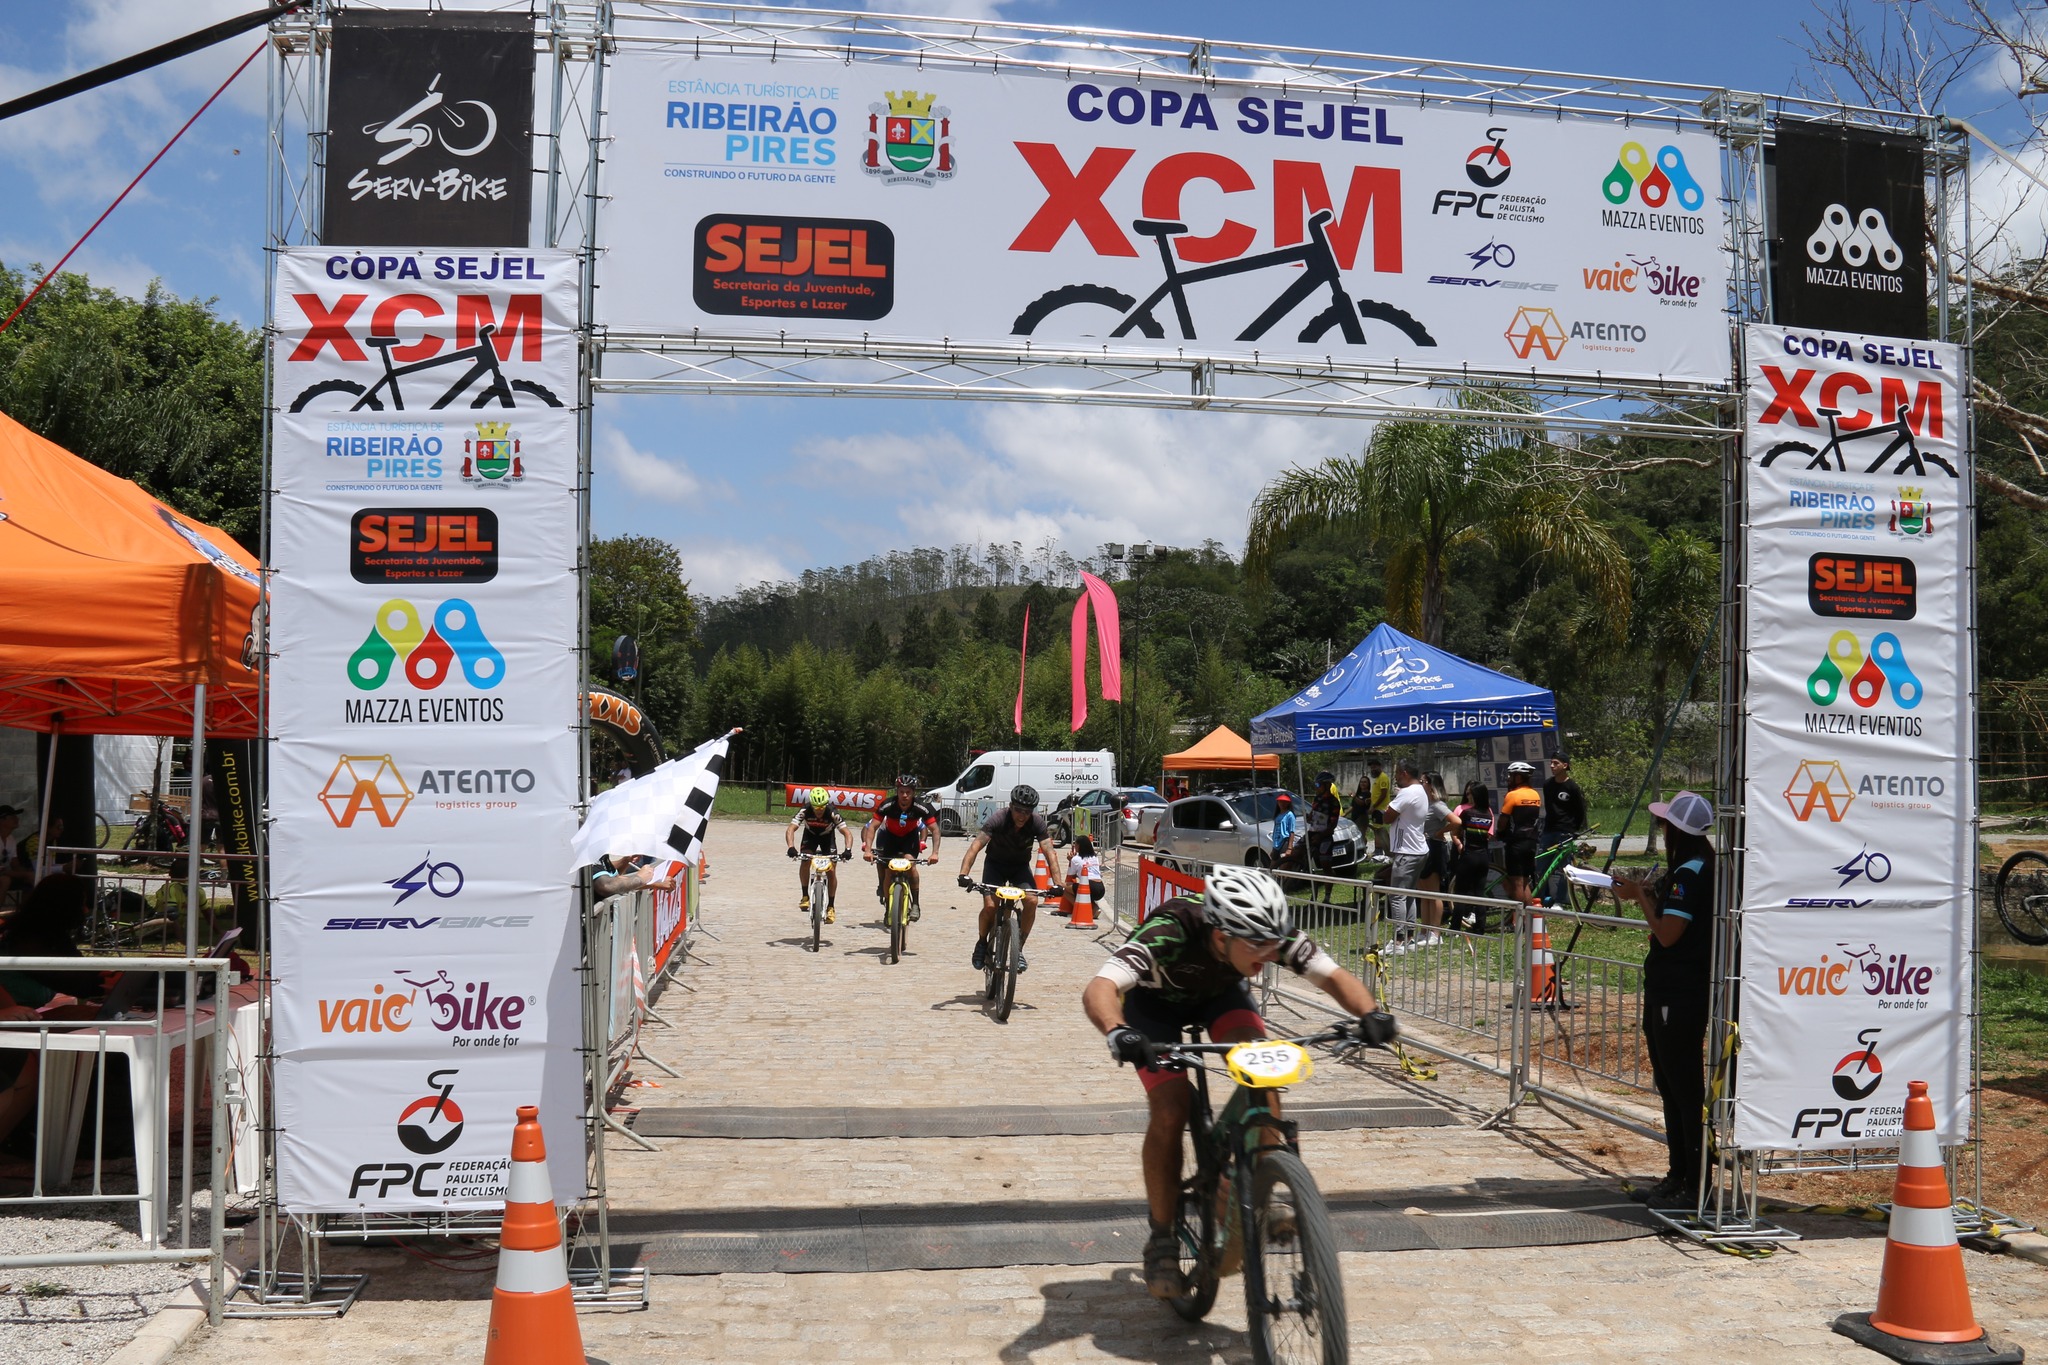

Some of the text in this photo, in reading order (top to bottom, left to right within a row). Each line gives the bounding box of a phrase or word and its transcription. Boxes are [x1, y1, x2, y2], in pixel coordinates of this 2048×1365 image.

[668, 78, 840, 100] ESTÂNCIA TURÍSTICA DE
[666, 101, 837, 135] RIBEIRÃO
[1067, 84, 1404, 146] COPA SEJEL
[726, 134, 836, 166] PIRES
[664, 168, 836, 184] CONSTRUINDO O FUTURO DA GENTE
[1007, 141, 1403, 274] XCM
[1432, 189, 1498, 219] FPC
[1499, 204, 1536, 214] PAULISTA
[1501, 194, 1547, 205] FEDERAÇÃO
[1497, 212, 1545, 224] DE CICLISMO
[1602, 209, 1705, 236] MAZZA EVENTOS
[704, 223, 886, 278] SEJEL
[325, 256, 545, 281] COPA SEJEL
[713, 279, 876, 297] Secretaria da Juventude,
[1806, 266, 1903, 293] MAZZA EVENTOS
[741, 296, 848, 311] Esportes e Lazer
[1671, 299, 1686, 307] onde
[1688, 300, 1698, 309] for
[287, 293, 543, 363] XCM
[1570, 321, 1647, 343] ATENTO
[1582, 343, 1636, 354] logistics group
[1783, 335, 1943, 370] COPA SEJEL
[1757, 365, 1944, 439] XCM
[327, 419, 444, 432] ESTÂNCIA TURÍSTICA DE
[326, 433, 443, 457] RIBEIRÃO
[367, 458, 443, 478] PIRES
[1789, 490, 1876, 512] RIBEIRÃO
[1820, 511, 1876, 530] PIRES
[358, 514, 493, 553] SEJEL
[364, 556, 484, 566] Secretaria da Juventude,
[385, 569, 426, 579] Esportes
[437, 569, 464, 577] Lazer
[1814, 558, 1913, 594] SEJEL
[1819, 593, 1856, 603] Secretaria
[1835, 604, 1866, 614] Esportes
[1873, 607, 1893, 615] Lazer
[345, 697, 504, 723] MAZZA EVENTOS
[577, 691, 643, 736] XXIS
[1307, 723, 1355, 741] Team
[1362, 713, 1446, 737] Serv-Bike
[1452, 706, 1541, 731] Heliópolis
[1804, 713, 1923, 737] MAZZA EVENTOS
[417, 768, 536, 794] ATENTO
[1054, 772, 1071, 781] SÃO
[1858, 774, 1945, 797] ATENTO
[435, 800, 517, 810] logistics group
[791, 788, 876, 809] MXXIS
[1871, 800, 1931, 810] logistics group
[1878, 999, 1928, 1011] Por onde for
[452, 1035, 519, 1049] Por onde for
[1244, 1050, 1291, 1066] 255
[1869, 1106, 1905, 1115] FEDERA
[1791, 1107, 1867, 1139] FPC
[1866, 1117, 1903, 1127] PAULIST
[1864, 1128, 1904, 1138] DE CICLIS
[348, 1162, 446, 1199] FPC
[445, 1173, 499, 1184] PAULISTA
[443, 1187, 458, 1197] DE
